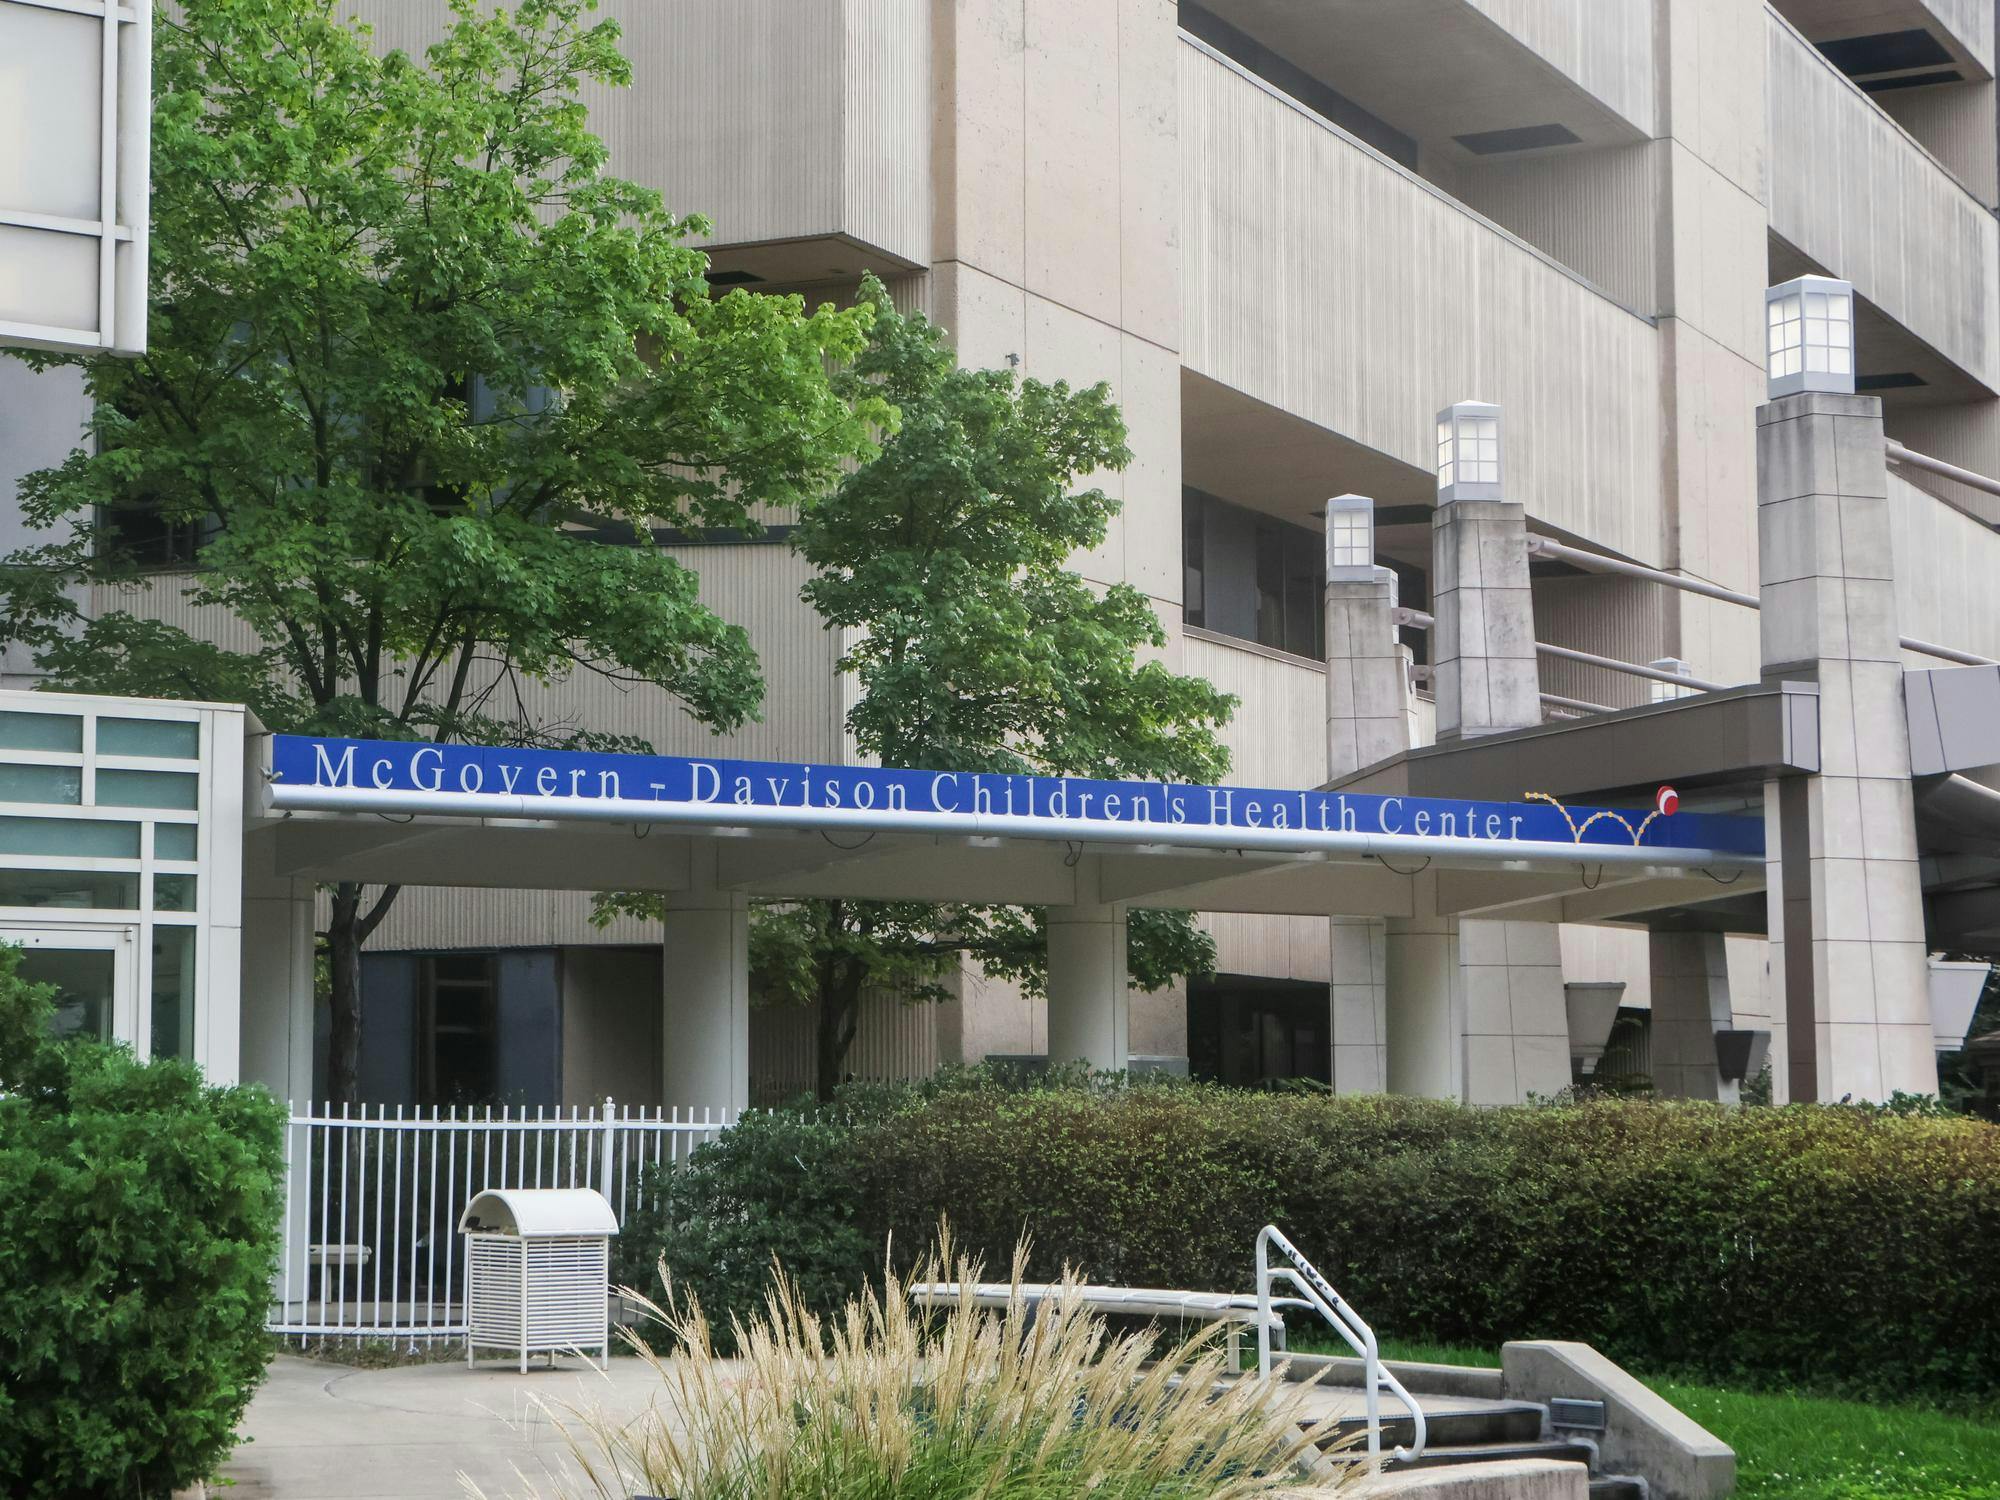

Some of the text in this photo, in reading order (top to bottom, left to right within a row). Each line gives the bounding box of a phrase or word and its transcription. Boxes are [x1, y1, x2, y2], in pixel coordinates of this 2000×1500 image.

[312, 743, 623, 799] McGovern
[689, 762, 907, 811] Davison
[931, 773, 1186, 824] Children's
[1209, 789, 1358, 832] Health
[1378, 798, 1523, 841] Center
